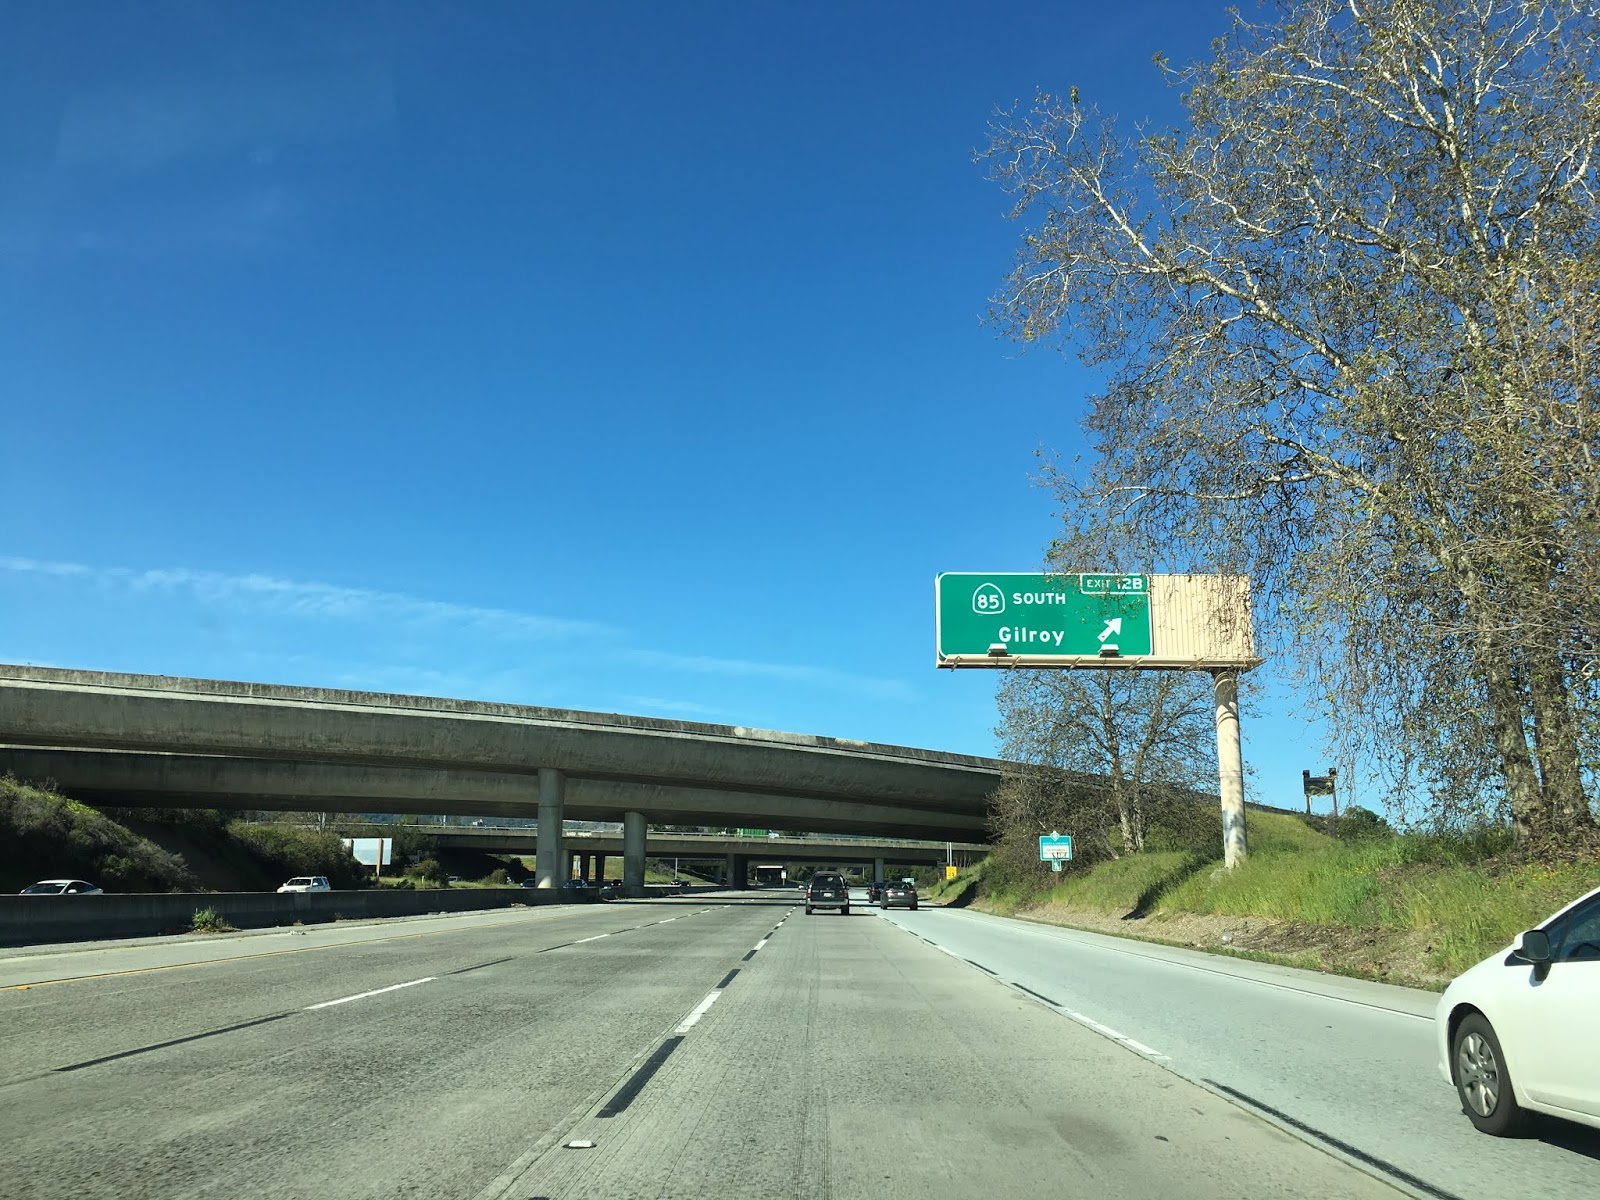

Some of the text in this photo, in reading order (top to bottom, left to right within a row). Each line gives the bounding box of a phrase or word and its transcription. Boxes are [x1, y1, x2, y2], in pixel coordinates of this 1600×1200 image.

[1086, 577, 1143, 590] EXIT 12B
[977, 592, 1066, 609] 85 SOUTH
[998, 626, 1065, 647] Gilroy
